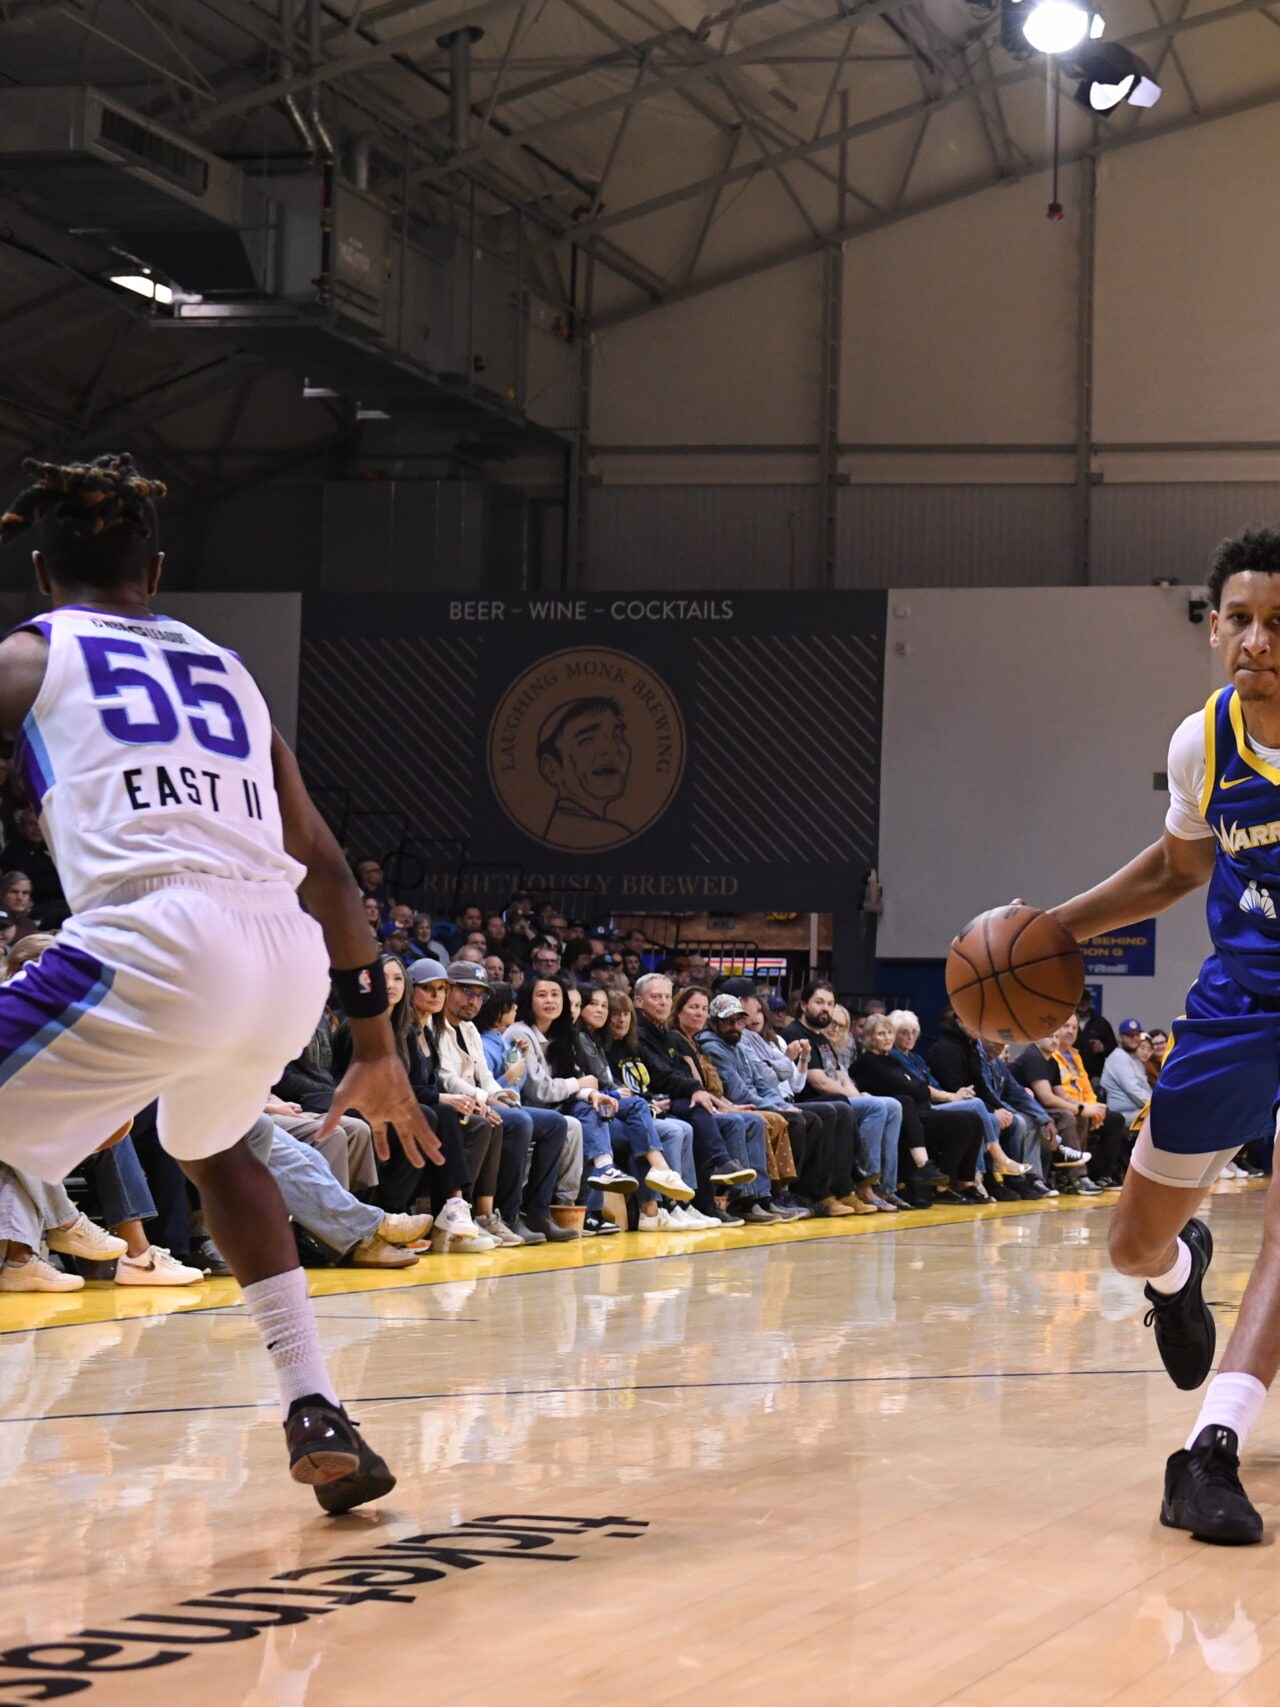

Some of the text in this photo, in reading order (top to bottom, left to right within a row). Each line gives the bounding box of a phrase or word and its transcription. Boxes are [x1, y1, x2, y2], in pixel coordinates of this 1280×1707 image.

[450, 600, 734, 620] BEER WINE COCKTAILS
[76, 634, 251, 762] 55
[501, 659, 674, 775] LAUGHING MONK BREWING
[123, 765, 220, 812] EAST
[622, 874, 739, 896] BREWED
[1092, 937, 1147, 946] BEHIND
